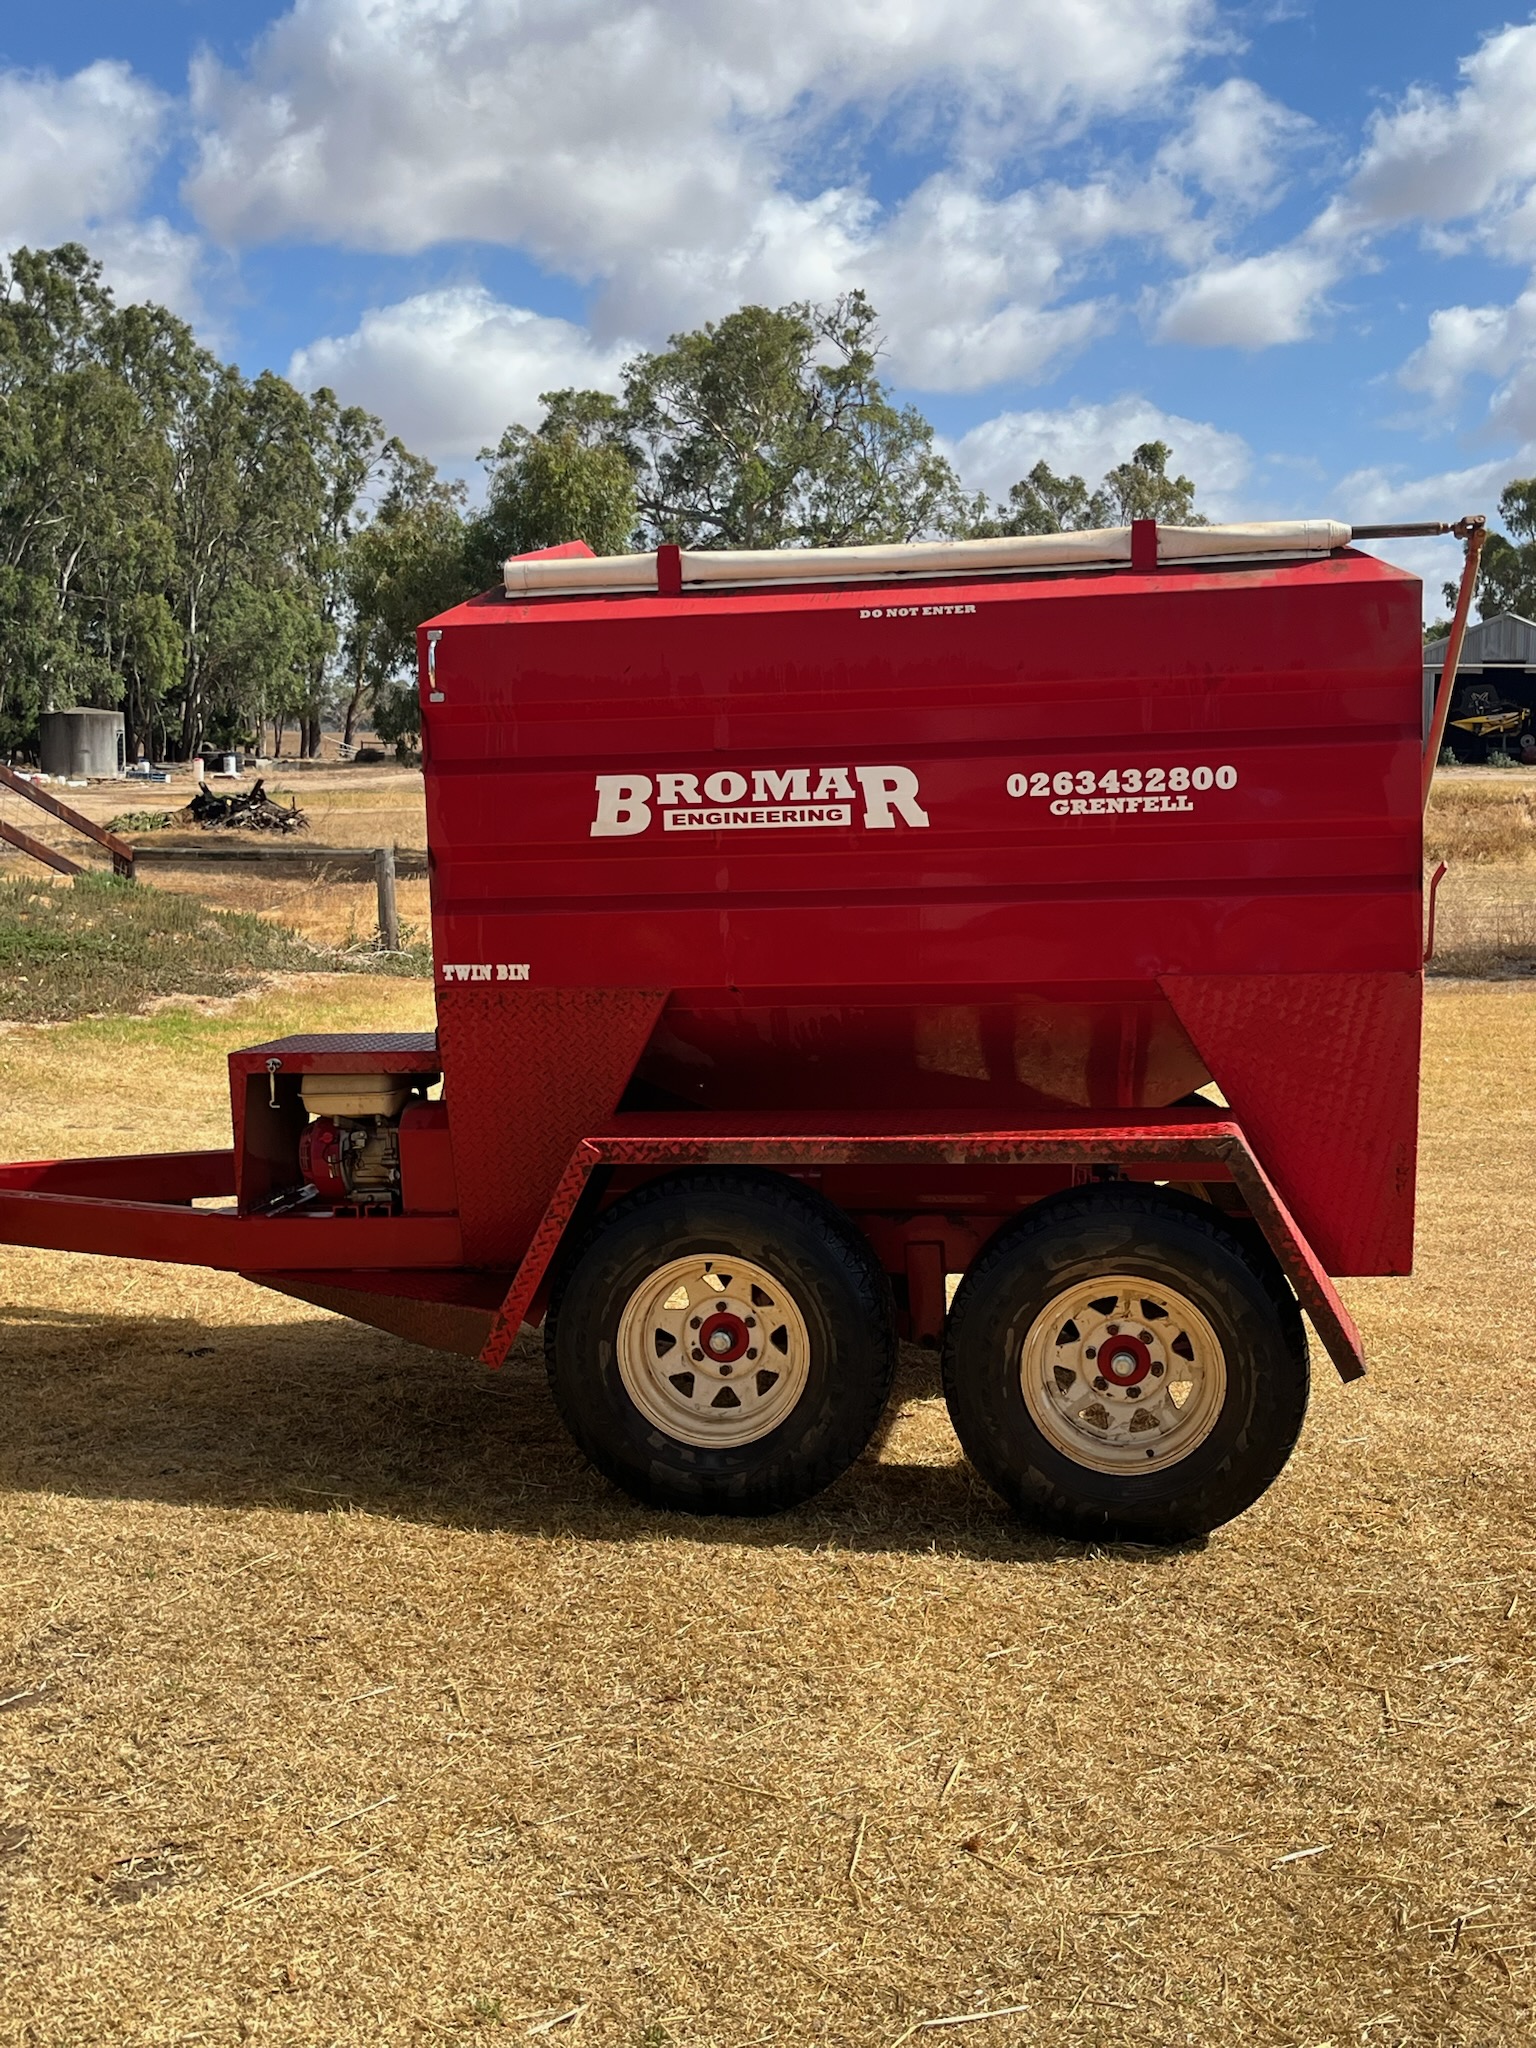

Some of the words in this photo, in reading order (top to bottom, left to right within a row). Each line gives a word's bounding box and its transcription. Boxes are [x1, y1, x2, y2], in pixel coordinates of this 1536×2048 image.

[859, 609, 883, 619] DO
[886, 607, 919, 618] NOT
[922, 604, 977, 616] ENTER
[1006, 765, 1238, 797] 0263432800
[591, 765, 930, 836] BROMAR
[1049, 795, 1194, 815] GRENFELL
[671, 808, 843, 826] ENGINEERING
[442, 964, 493, 981] TWIN
[496, 963, 531, 981] BIN
